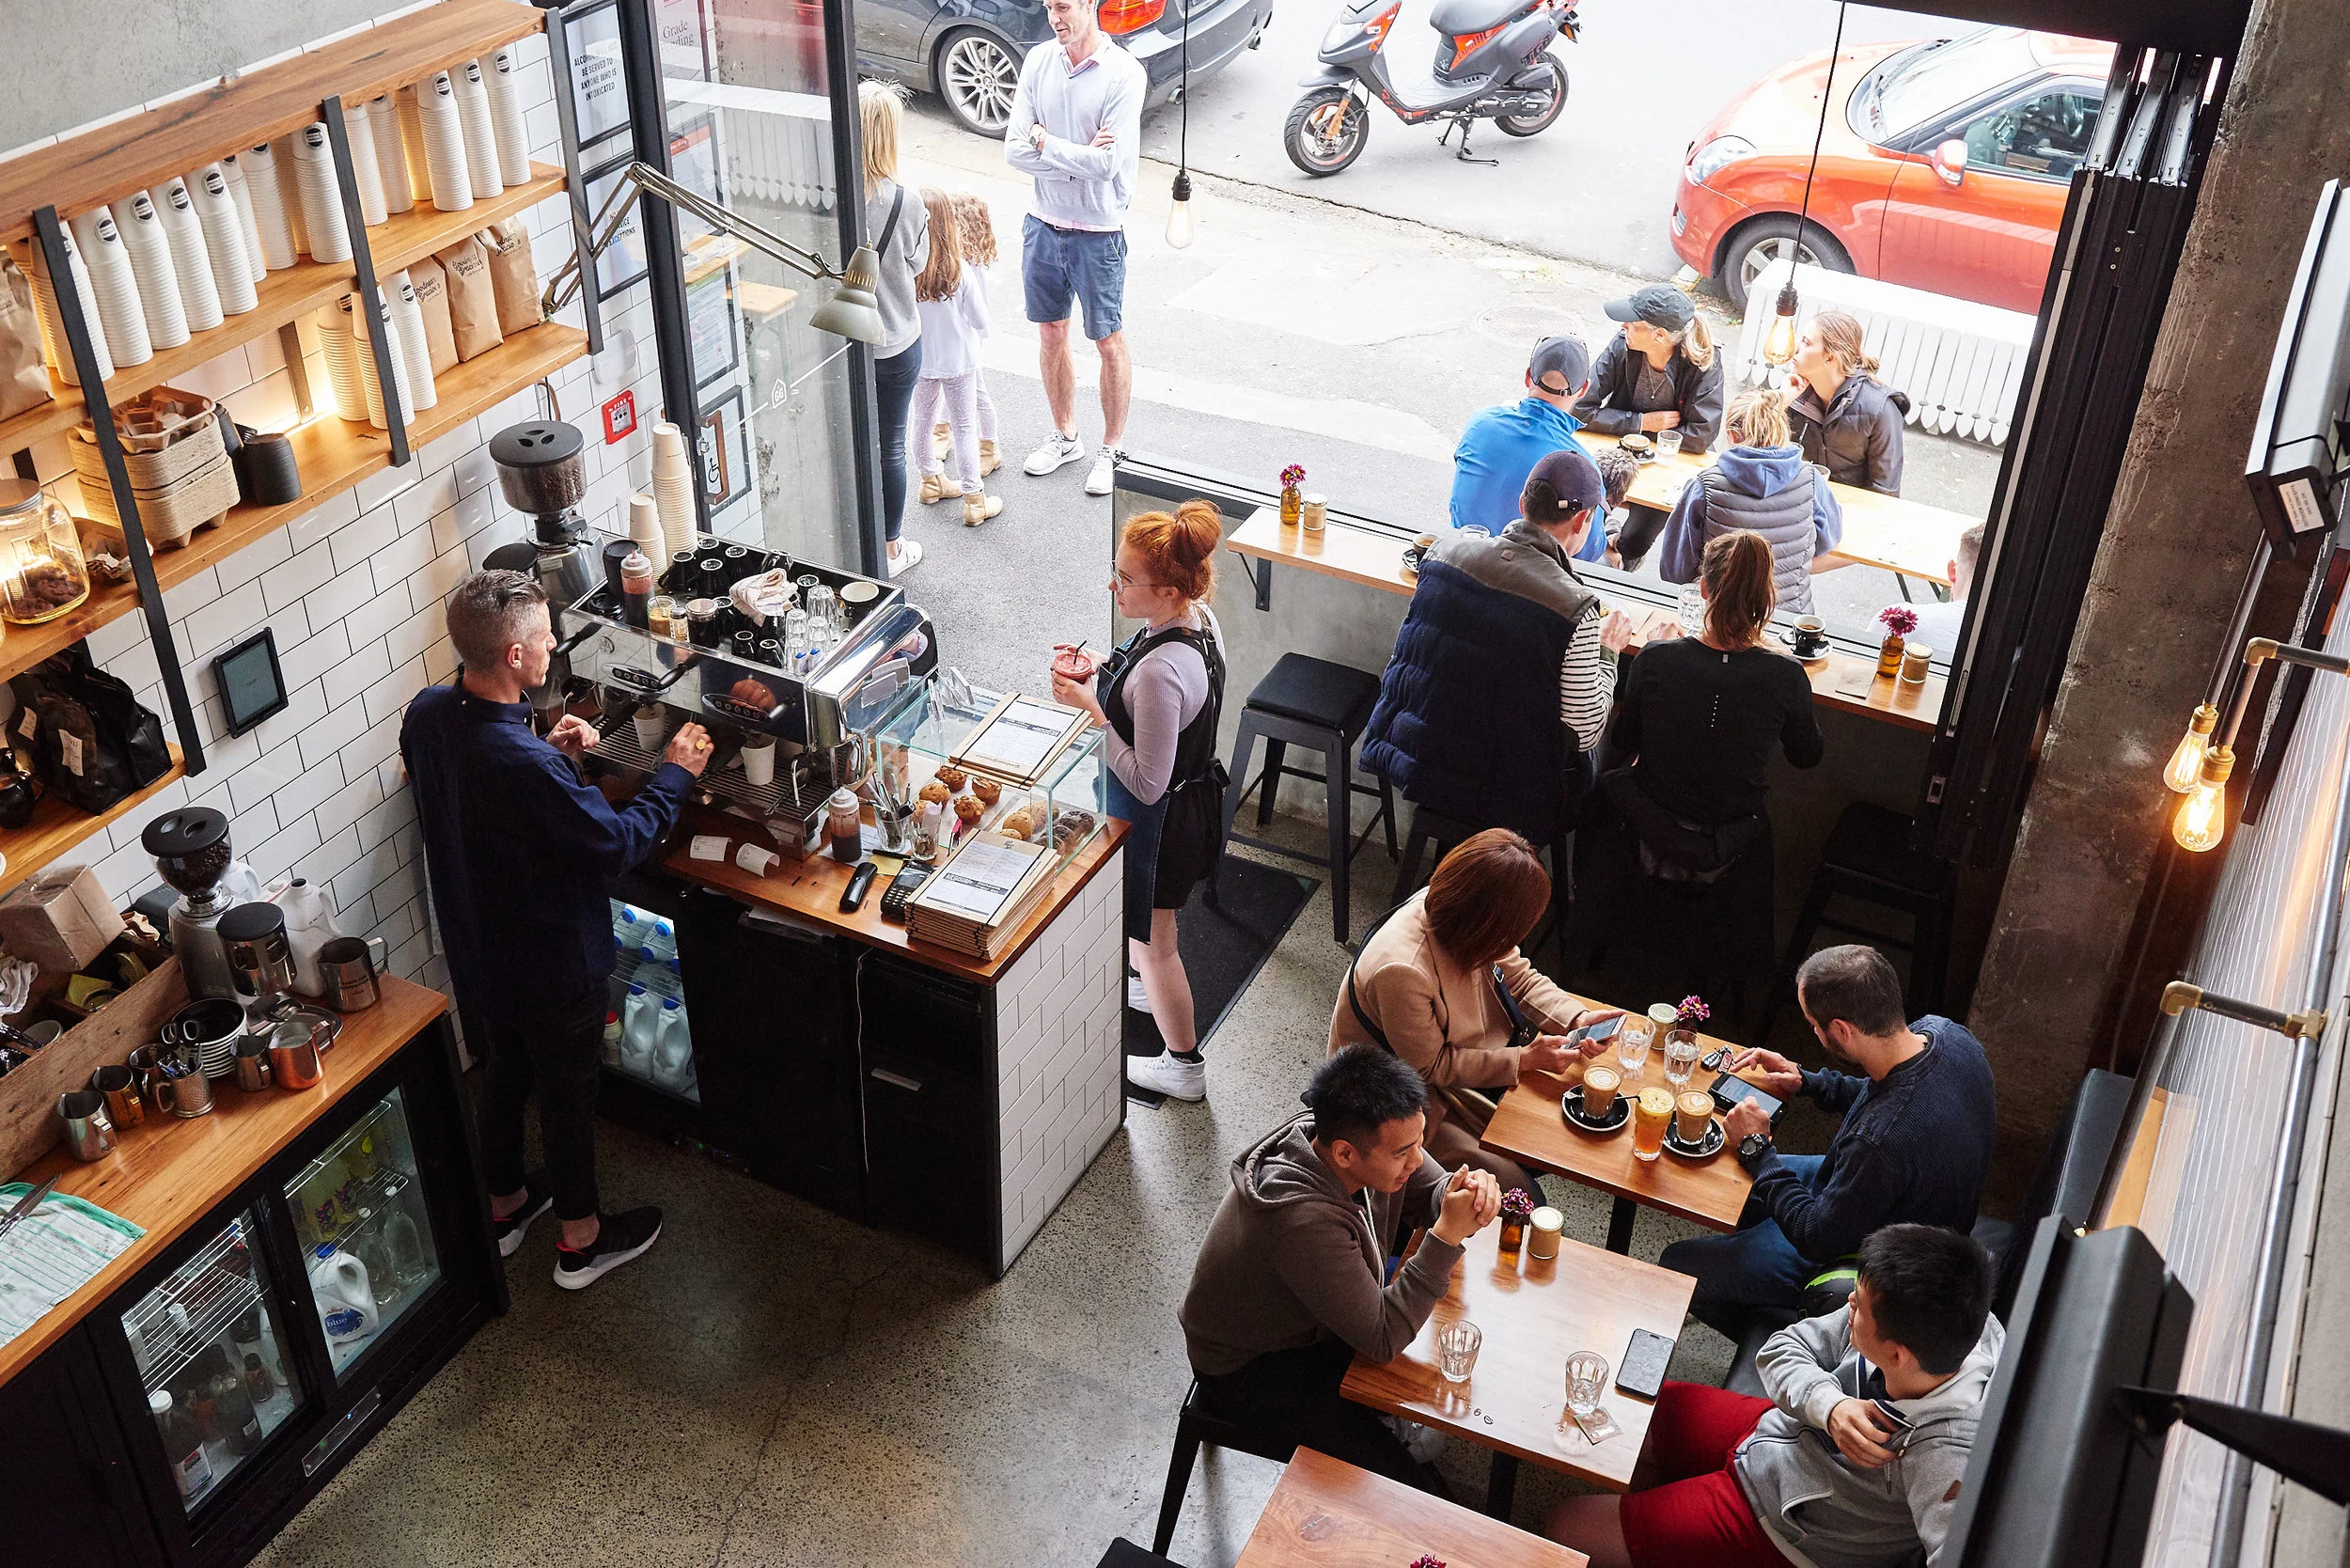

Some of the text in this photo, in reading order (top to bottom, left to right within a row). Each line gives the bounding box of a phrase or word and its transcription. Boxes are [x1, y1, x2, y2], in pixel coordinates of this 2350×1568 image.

[663, 20, 688, 39] Grade
[582, 57, 614, 76] BE SERVED TO
[581, 68, 617, 90] ANYONE WHO IS
[585, 82, 616, 102] INTOXICATED
[326, 1317, 348, 1327] blue
